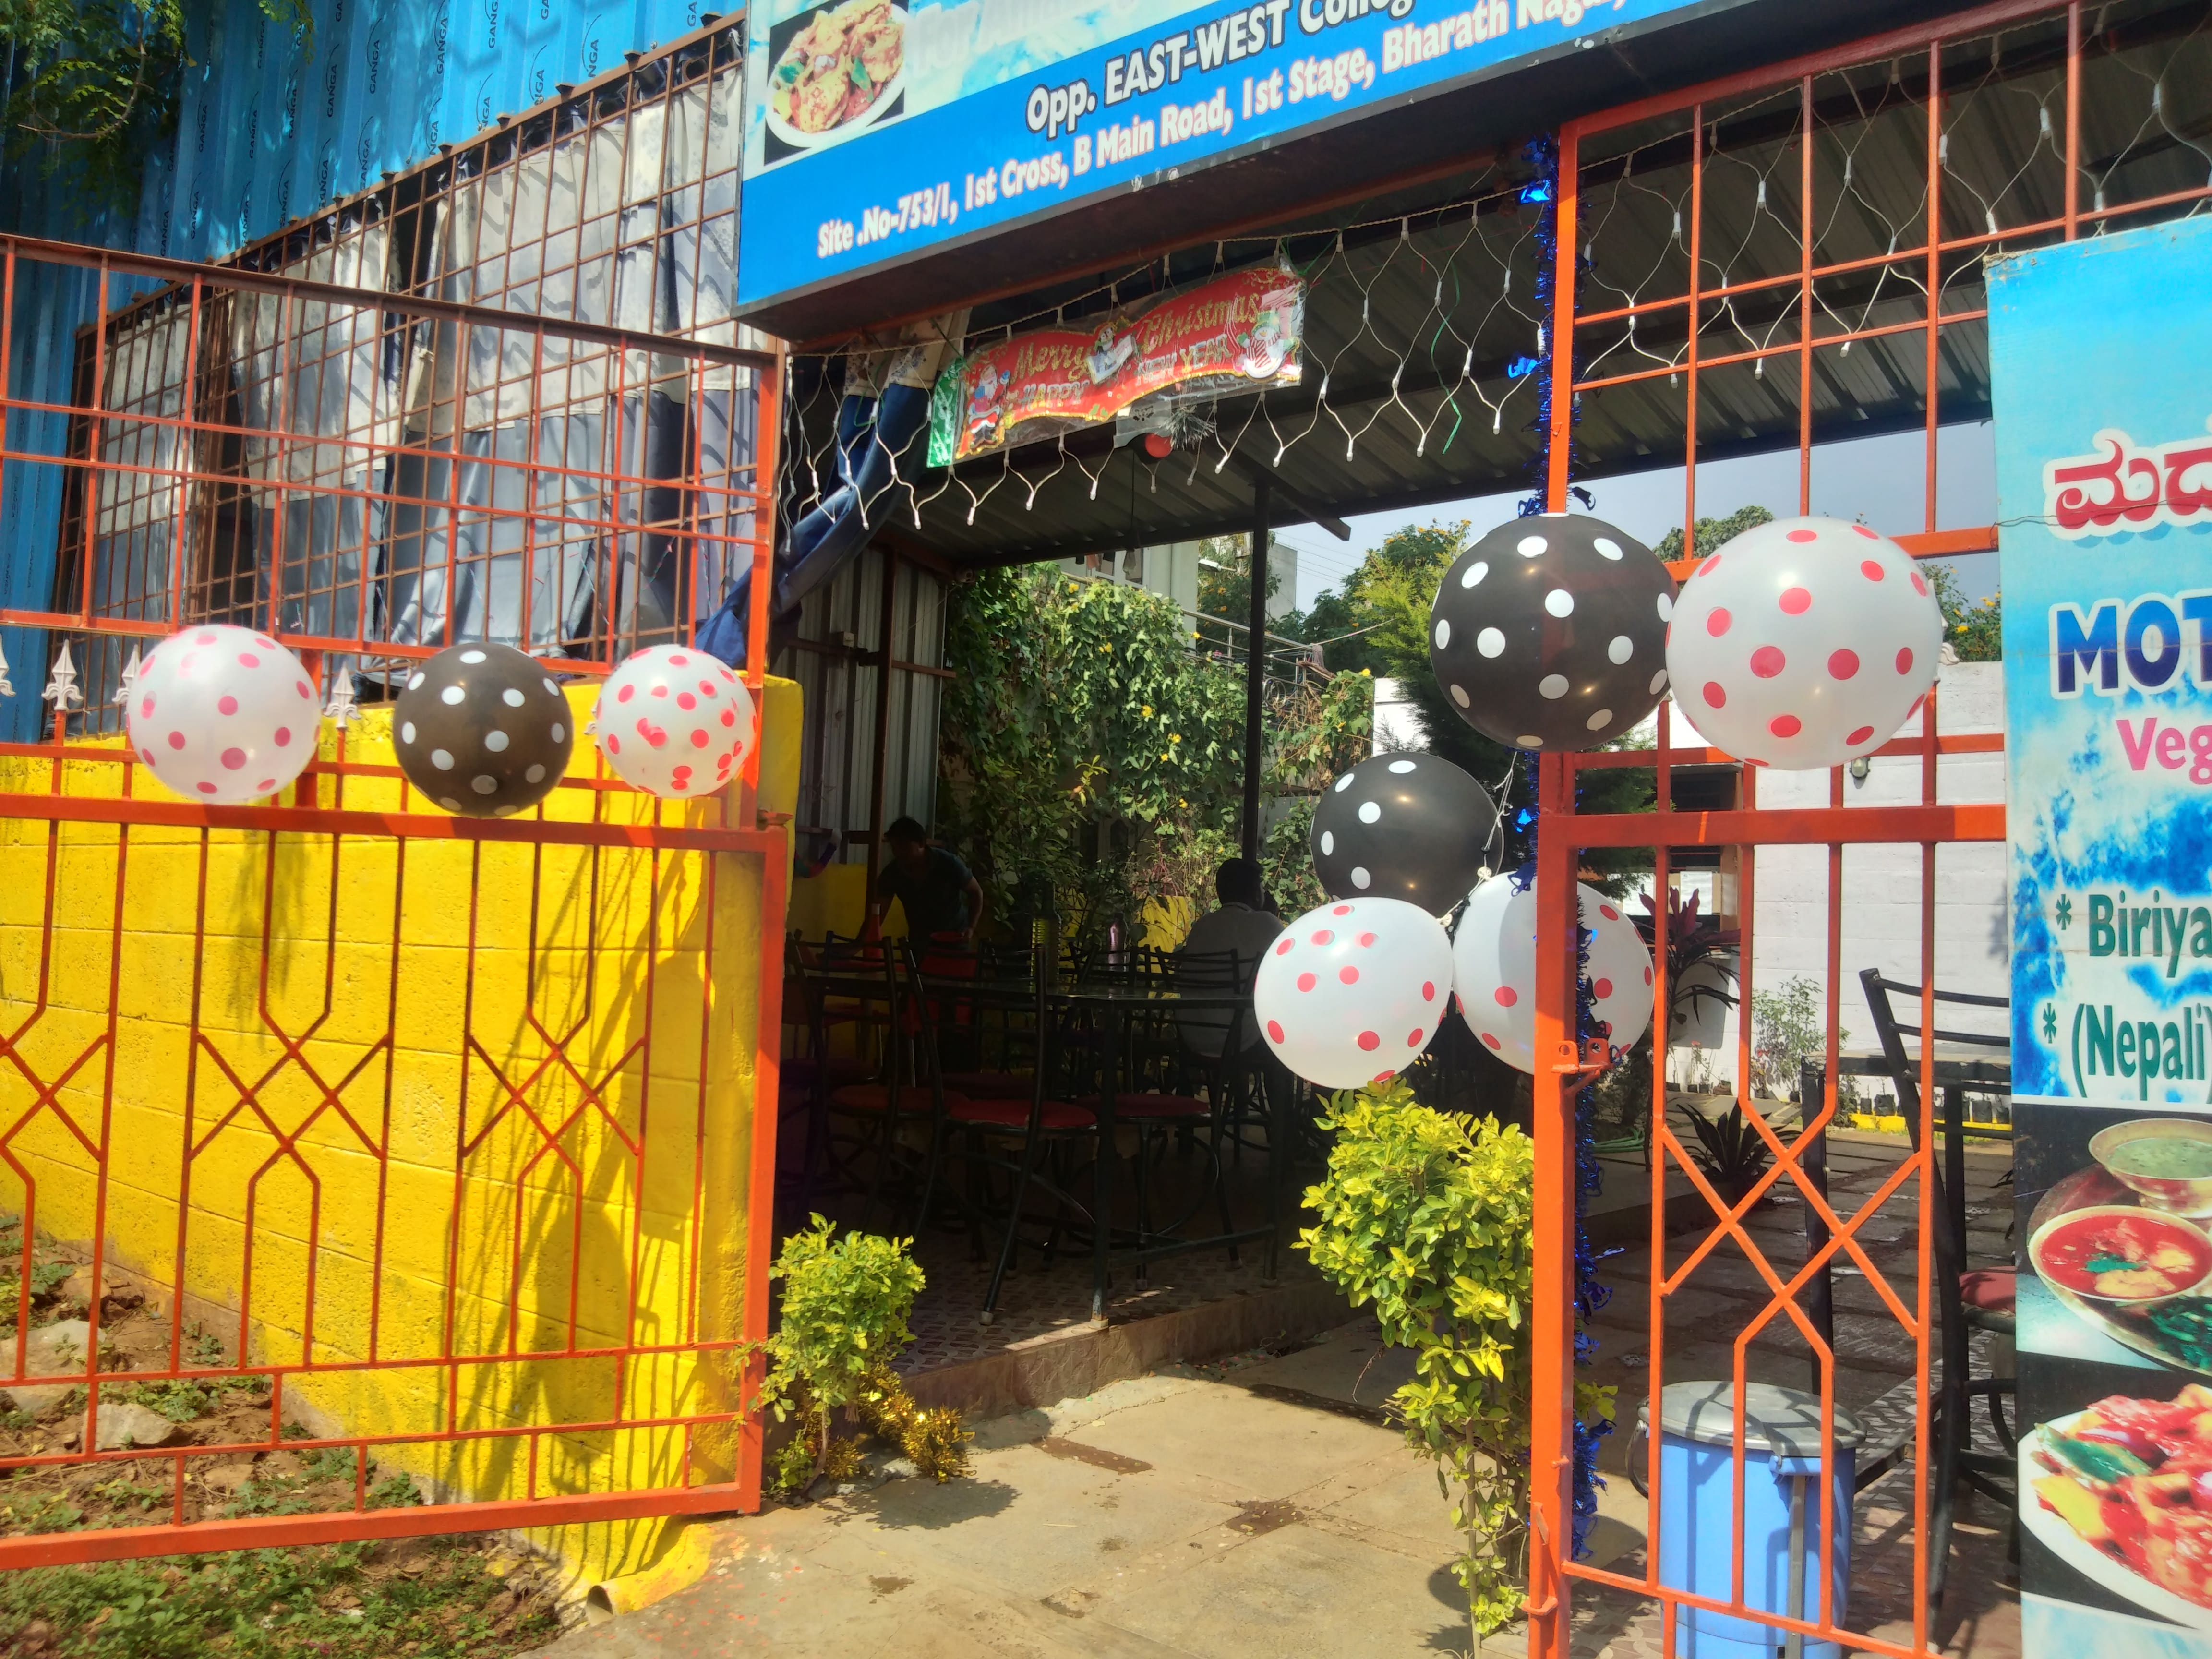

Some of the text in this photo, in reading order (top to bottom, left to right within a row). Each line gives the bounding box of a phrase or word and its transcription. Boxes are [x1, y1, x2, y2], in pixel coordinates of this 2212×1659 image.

[369, 40, 380, 94] GANGA
[436, 18, 448, 74] GANGA
[1027, 79, 1097, 140] Opp.
[1104, 0, 1291, 106] EAST-WEST
[289, 88, 298, 139] GANGA
[327, 64, 337, 118] GANGA
[199, 105, 207, 153] GANGA
[249, 109, 258, 159] GANGA
[818, 218, 854, 258] Site
[1000, 150, 1069, 198] Cross,
[1073, 135, 1092, 175] B
[1096, 119, 1154, 168] Main
[1160, 86, 1233, 148] Road,
[1289, 47, 1376, 100] Stage,
[1382, 0, 1509, 74] Bharath
[160, 210, 169, 257] GANGA
[191, 192, 199, 240] GANGA
[1014, 291, 1262, 382] Merry Christmas
[1018, 334, 1232, 411] HAPPY NEW YEAR
[2116, 717, 2212, 786] Veg
[2088, 890, 2212, 978] Biriya
